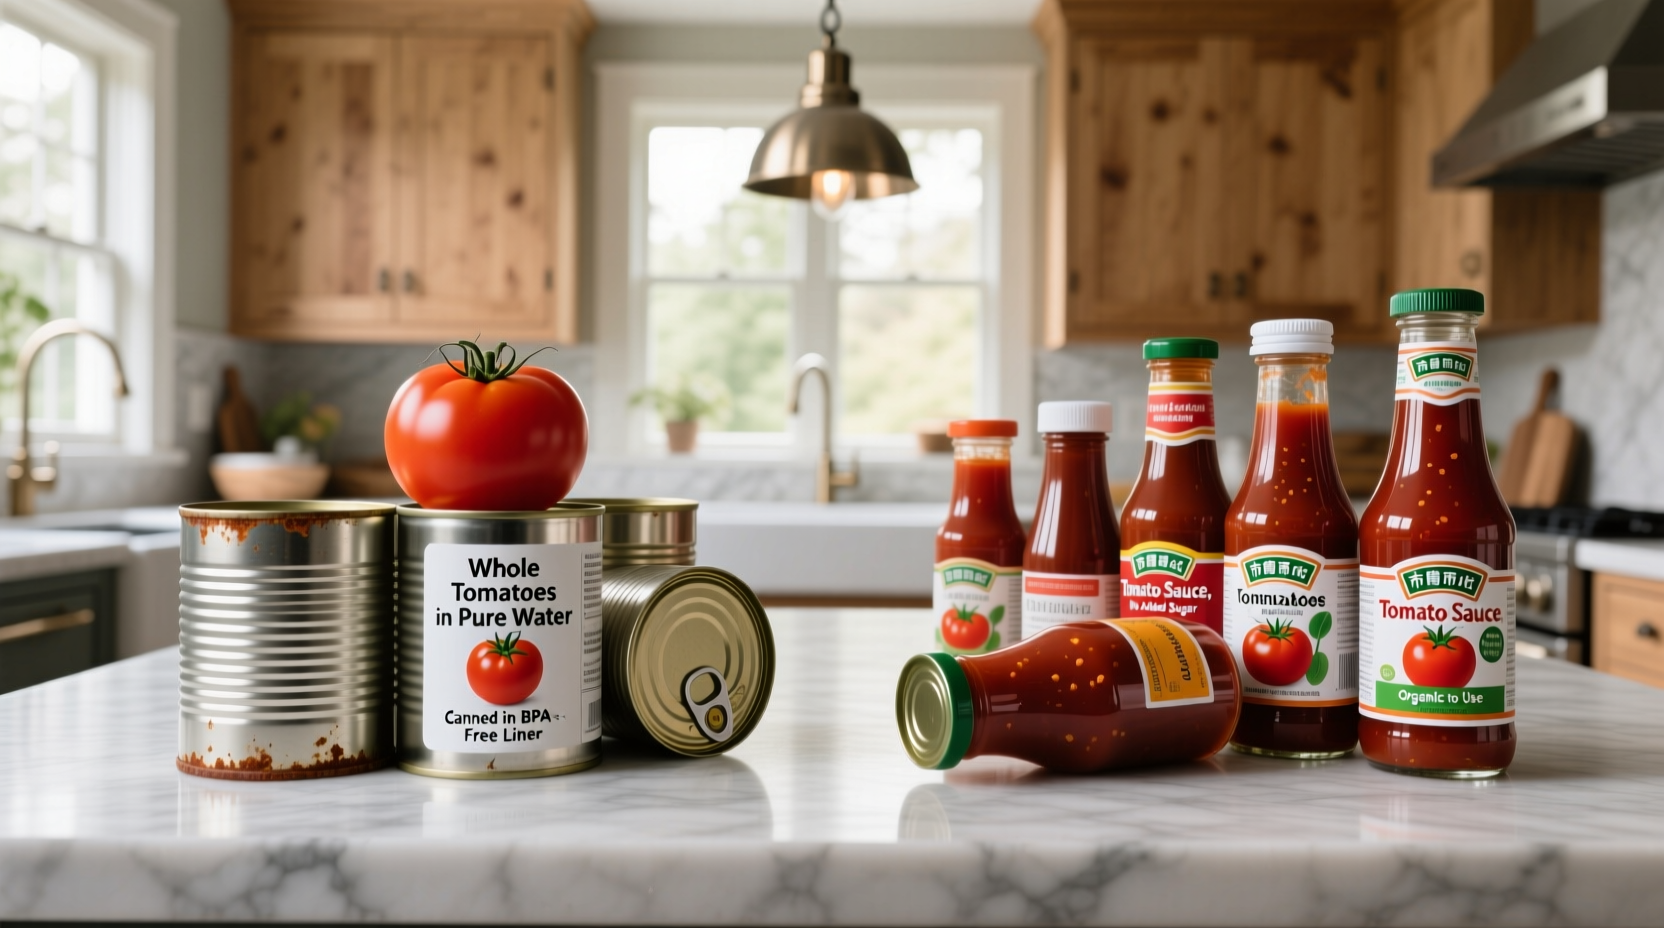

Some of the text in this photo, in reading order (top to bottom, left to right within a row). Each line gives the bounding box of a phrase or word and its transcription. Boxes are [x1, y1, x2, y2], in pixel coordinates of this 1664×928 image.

[468, 557, 540, 577] Whole
[451, 582, 557, 602] Tomatoes
[1163, 581, 1212, 601] Sauce,
[436, 607, 573, 627] in Pure Water
[1379, 599, 1448, 622] Tomato
[1447, 691, 1459, 704] to
[444, 710, 498, 725] Canned
[502, 711, 516, 725] in
[464, 727, 543, 742] Free Liner
